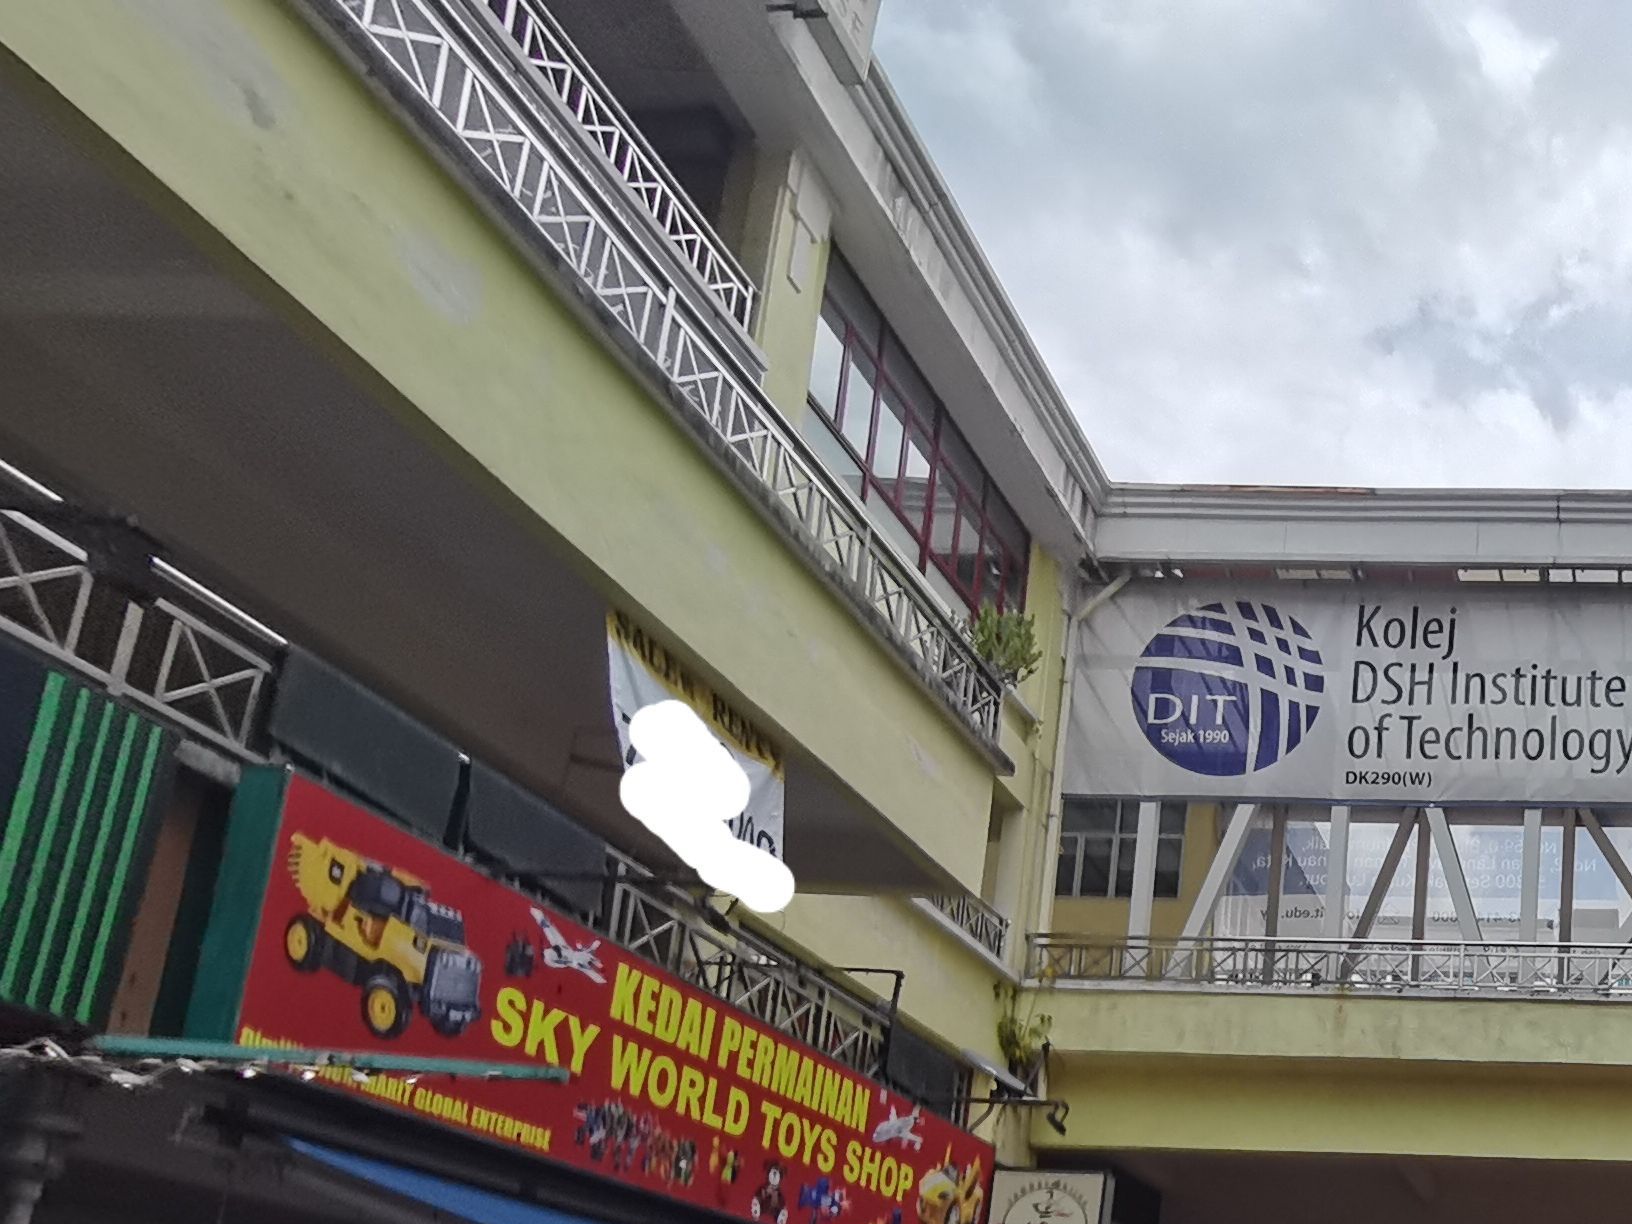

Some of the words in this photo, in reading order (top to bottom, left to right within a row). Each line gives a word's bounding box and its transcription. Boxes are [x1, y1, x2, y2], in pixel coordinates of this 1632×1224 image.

[1355, 604, 1458, 661] Kolej
[1350, 660, 1435, 706] DSH
[1449, 660, 1627, 708] Institute
[1146, 693, 1238, 725] DIT
[1160, 728, 1196, 747] Sejak
[1199, 729, 1230, 744] 1990
[1346, 712, 1393, 760] of
[1345, 770, 1432, 788] DK290(W)
[609, 961, 717, 1062] KEDAI
[716, 1015, 872, 1133] PERMAINAN
[413, 1087, 469, 1125] GLOBAL
[490, 986, 601, 1077] SKY
[609, 1034, 750, 1138] WORLD
[760, 1100, 838, 1174] TOYS
[842, 1139, 914, 1204] SHOP
